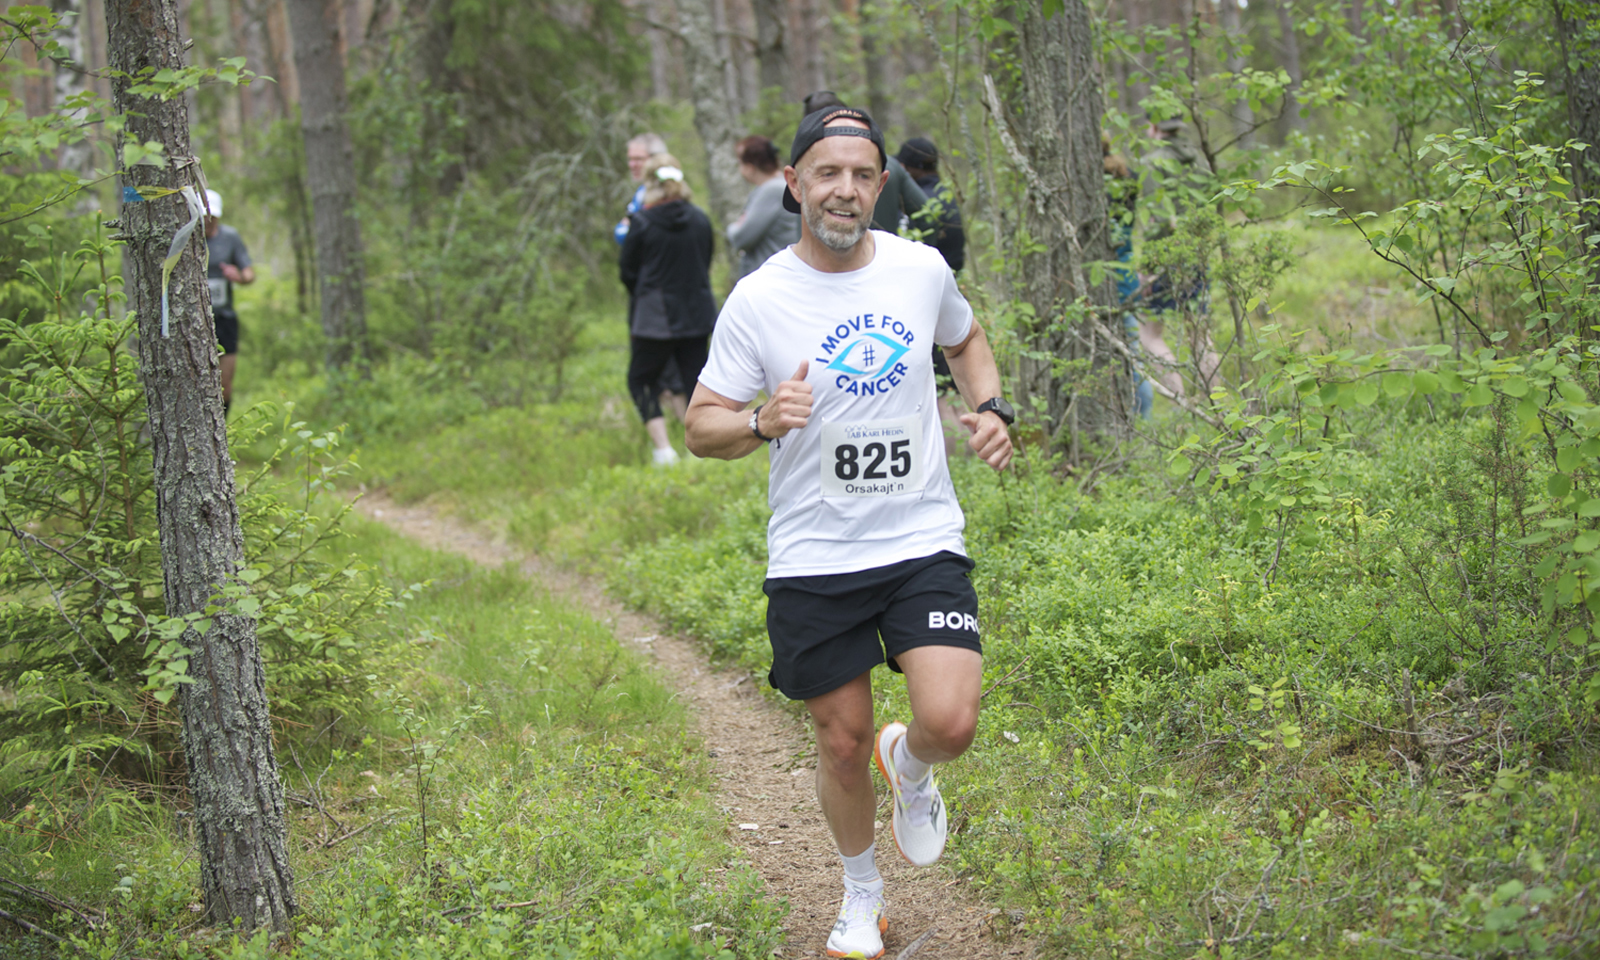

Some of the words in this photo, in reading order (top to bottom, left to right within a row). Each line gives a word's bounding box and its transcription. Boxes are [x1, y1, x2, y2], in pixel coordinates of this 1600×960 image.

[821, 314, 875, 355] MOVE
[881, 315, 914, 346] FOR
[835, 362, 908, 396] CANCER
[834, 439, 911, 481] 825
